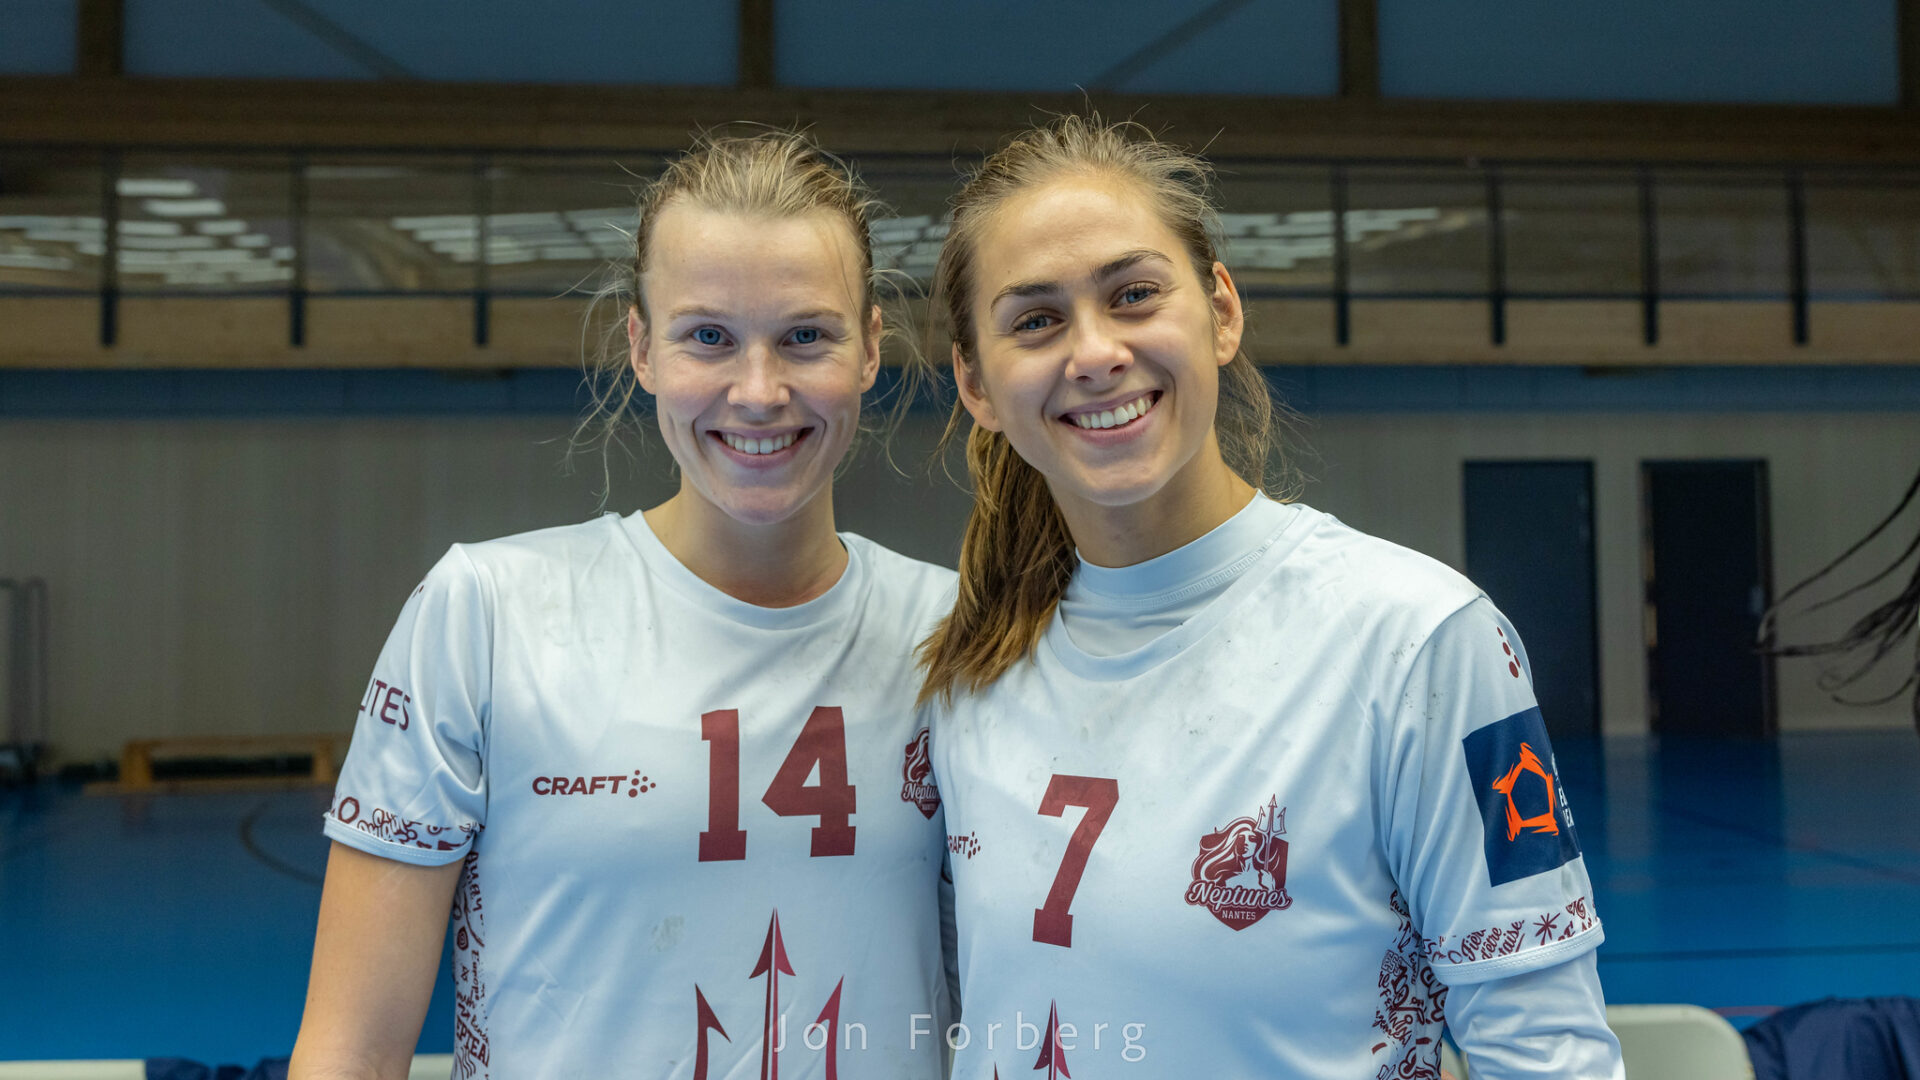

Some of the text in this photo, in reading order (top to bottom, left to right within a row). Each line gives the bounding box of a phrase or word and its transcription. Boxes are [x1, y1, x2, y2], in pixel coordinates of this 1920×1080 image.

[532, 775, 627, 796] CRAFT
[698, 706, 856, 862] 14
[1032, 774, 1119, 948] 7
[1187, 881, 1289, 911] Neptunes
[1221, 909, 1257, 921] NANTES
